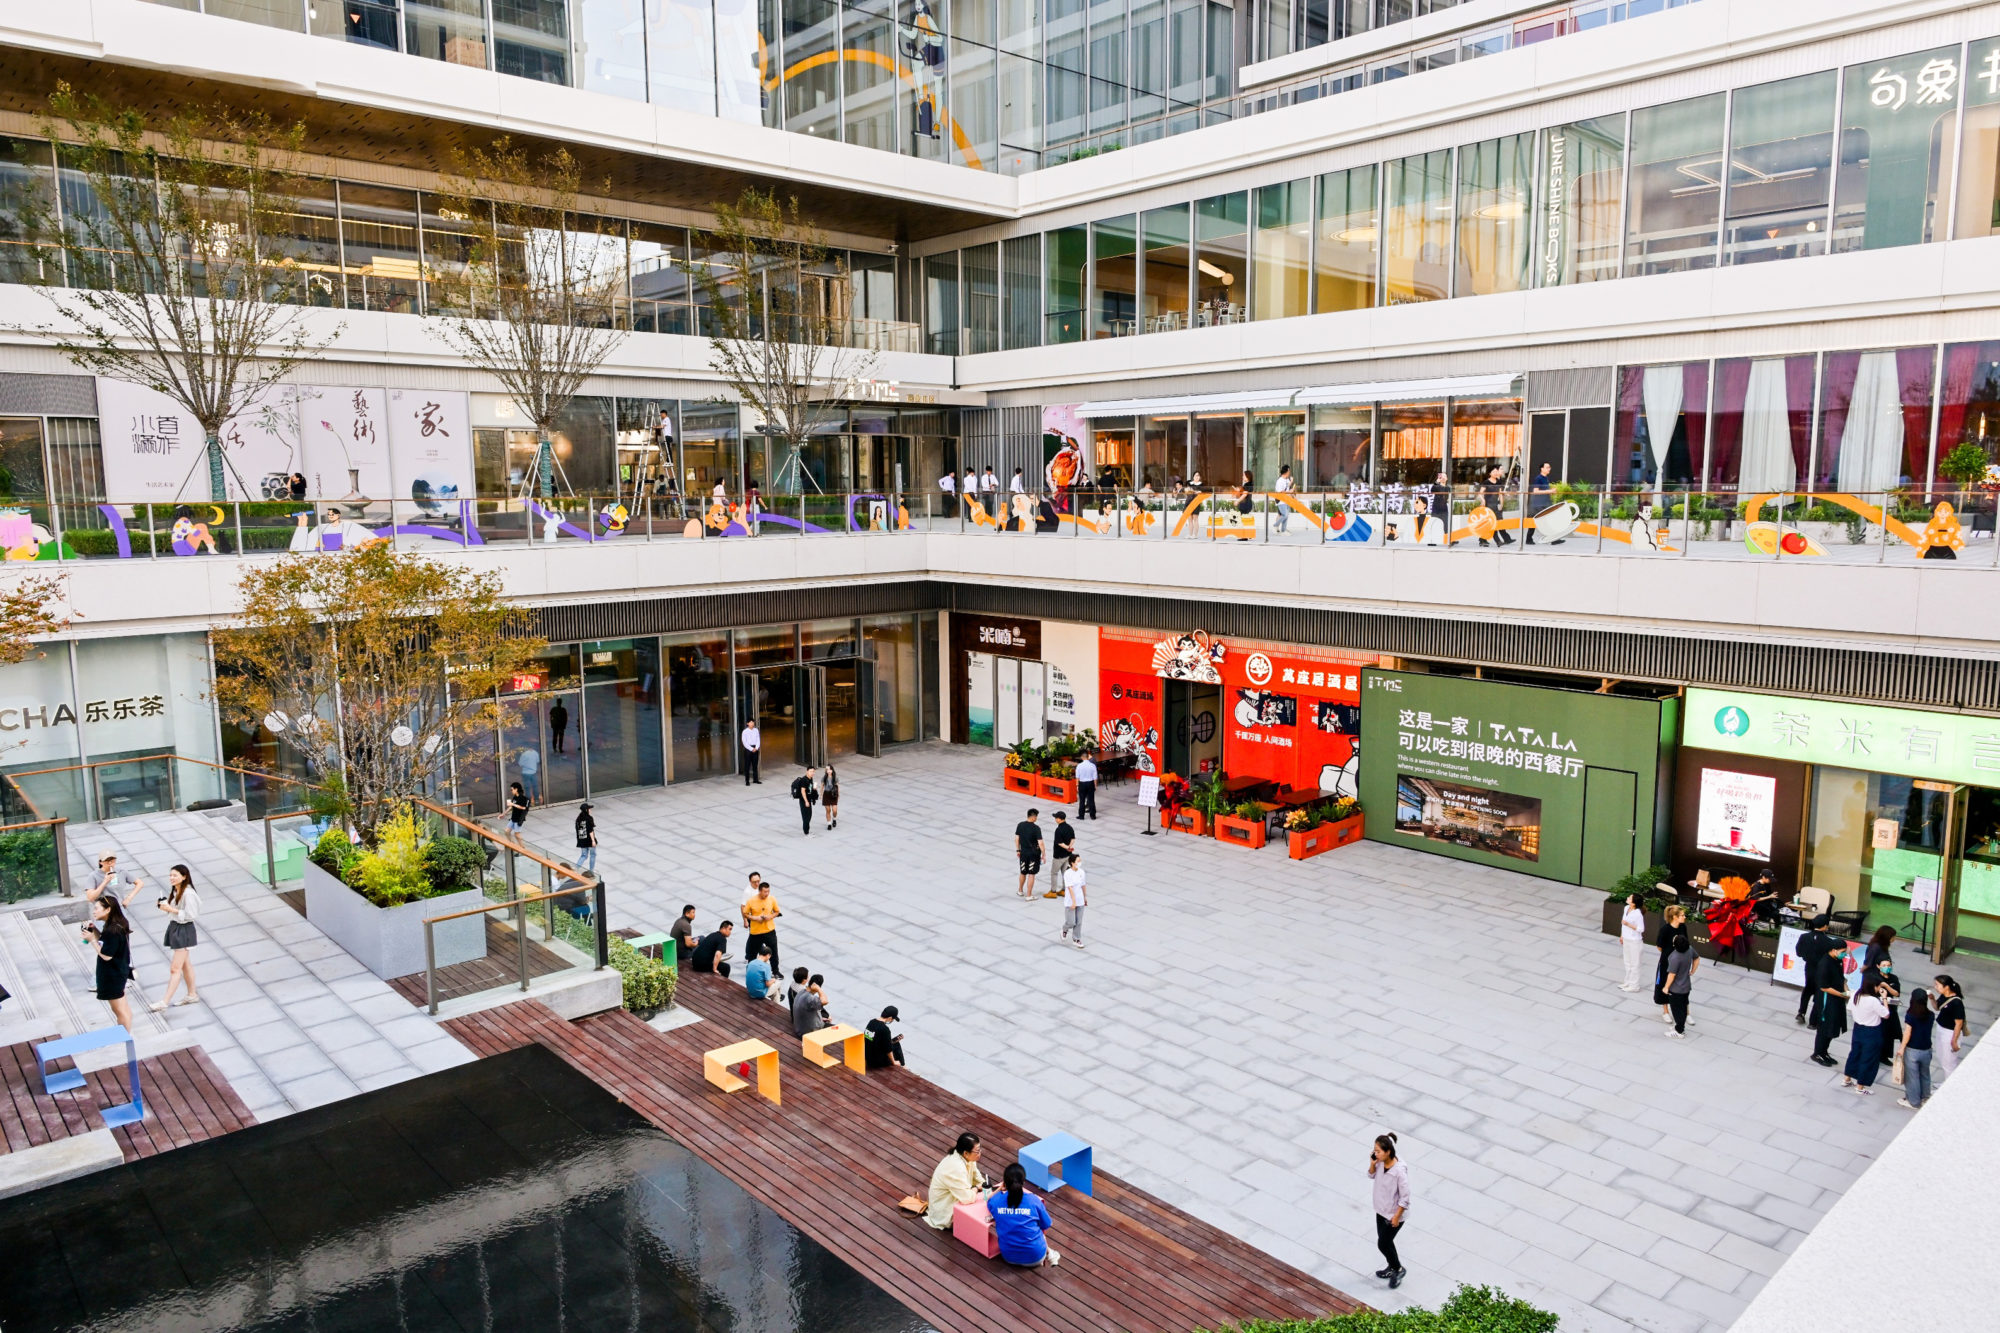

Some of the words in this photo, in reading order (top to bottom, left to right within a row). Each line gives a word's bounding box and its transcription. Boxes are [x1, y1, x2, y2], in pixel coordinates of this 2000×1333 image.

[1551, 135, 1566, 176] JUNE
[1549, 178, 1562, 225] SHINE
[415, 401, 450, 438] 家
[85, 694, 165, 723] 乐乐茶
[1398, 708, 1469, 737] 这是一家
[1398, 731, 1584, 778] 可以吃到很晚的西餐厅
[1771, 710, 2000, 773] 茶米有言
[1441, 762, 1469, 772] restaurant
[1460, 773, 1471, 781] into
[1443, 791, 1456, 800] Day
[1471, 796, 1489, 805] night
[1470, 805, 1492, 813] OPENING
[1015, 1207, 1031, 1216] STORE
